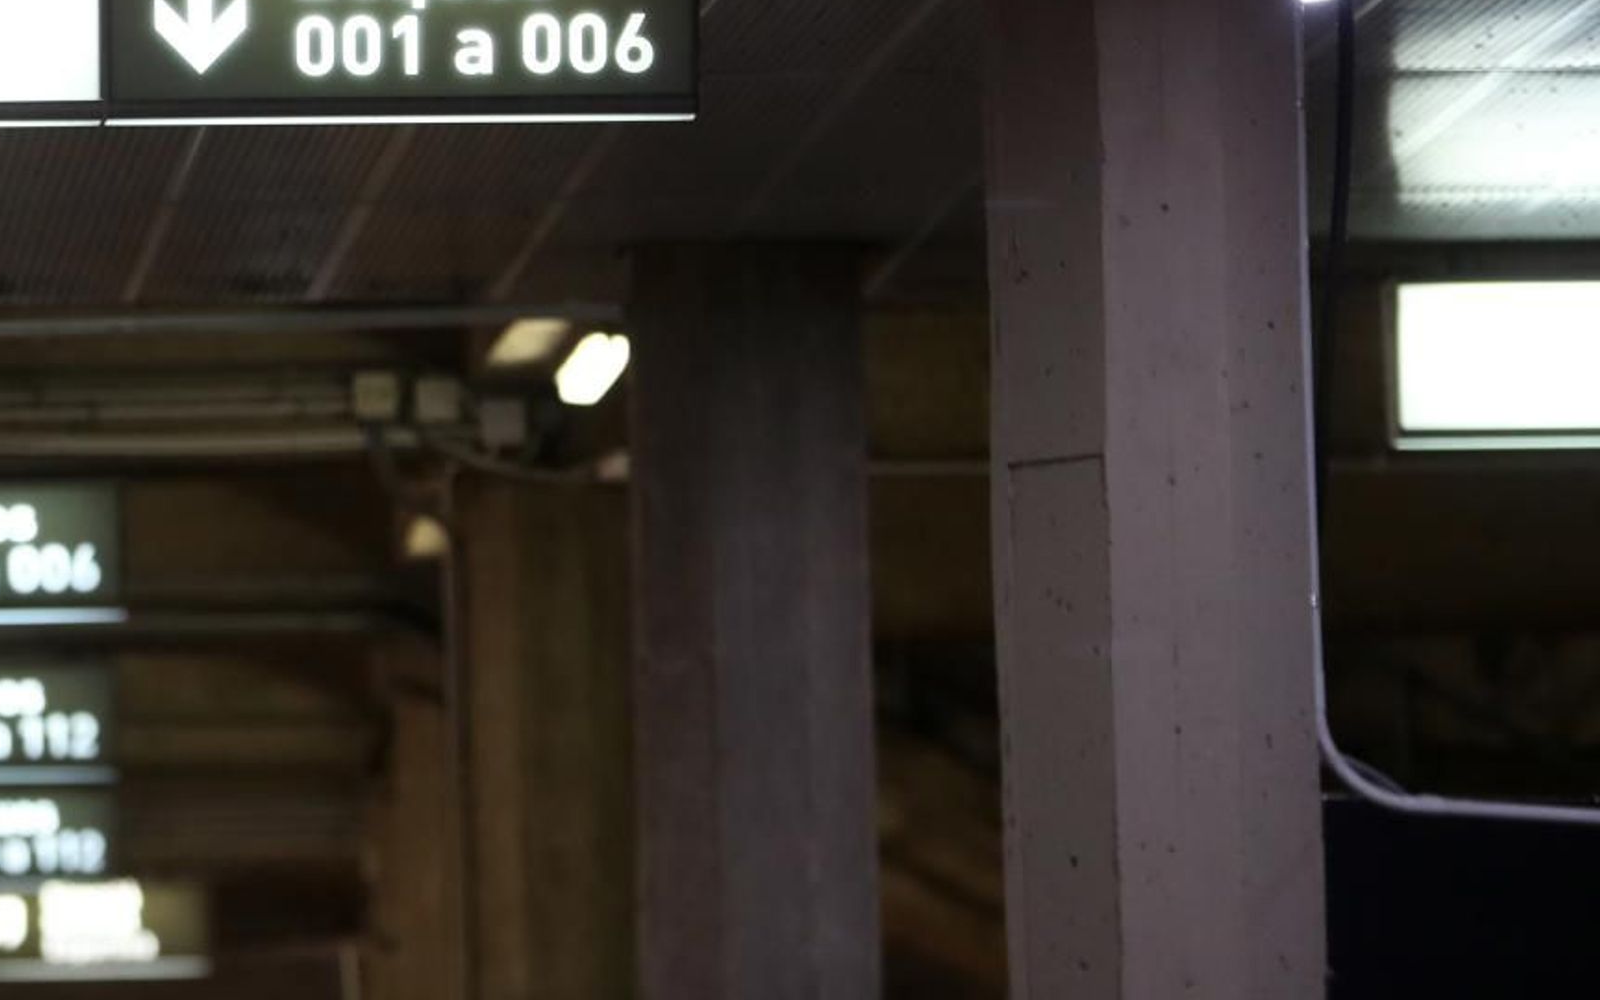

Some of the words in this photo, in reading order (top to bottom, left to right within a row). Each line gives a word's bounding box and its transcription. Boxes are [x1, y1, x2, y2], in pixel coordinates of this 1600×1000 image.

[294, 14, 420, 76] 001
[455, 29, 494, 75] a
[521, 12, 654, 74] 006
